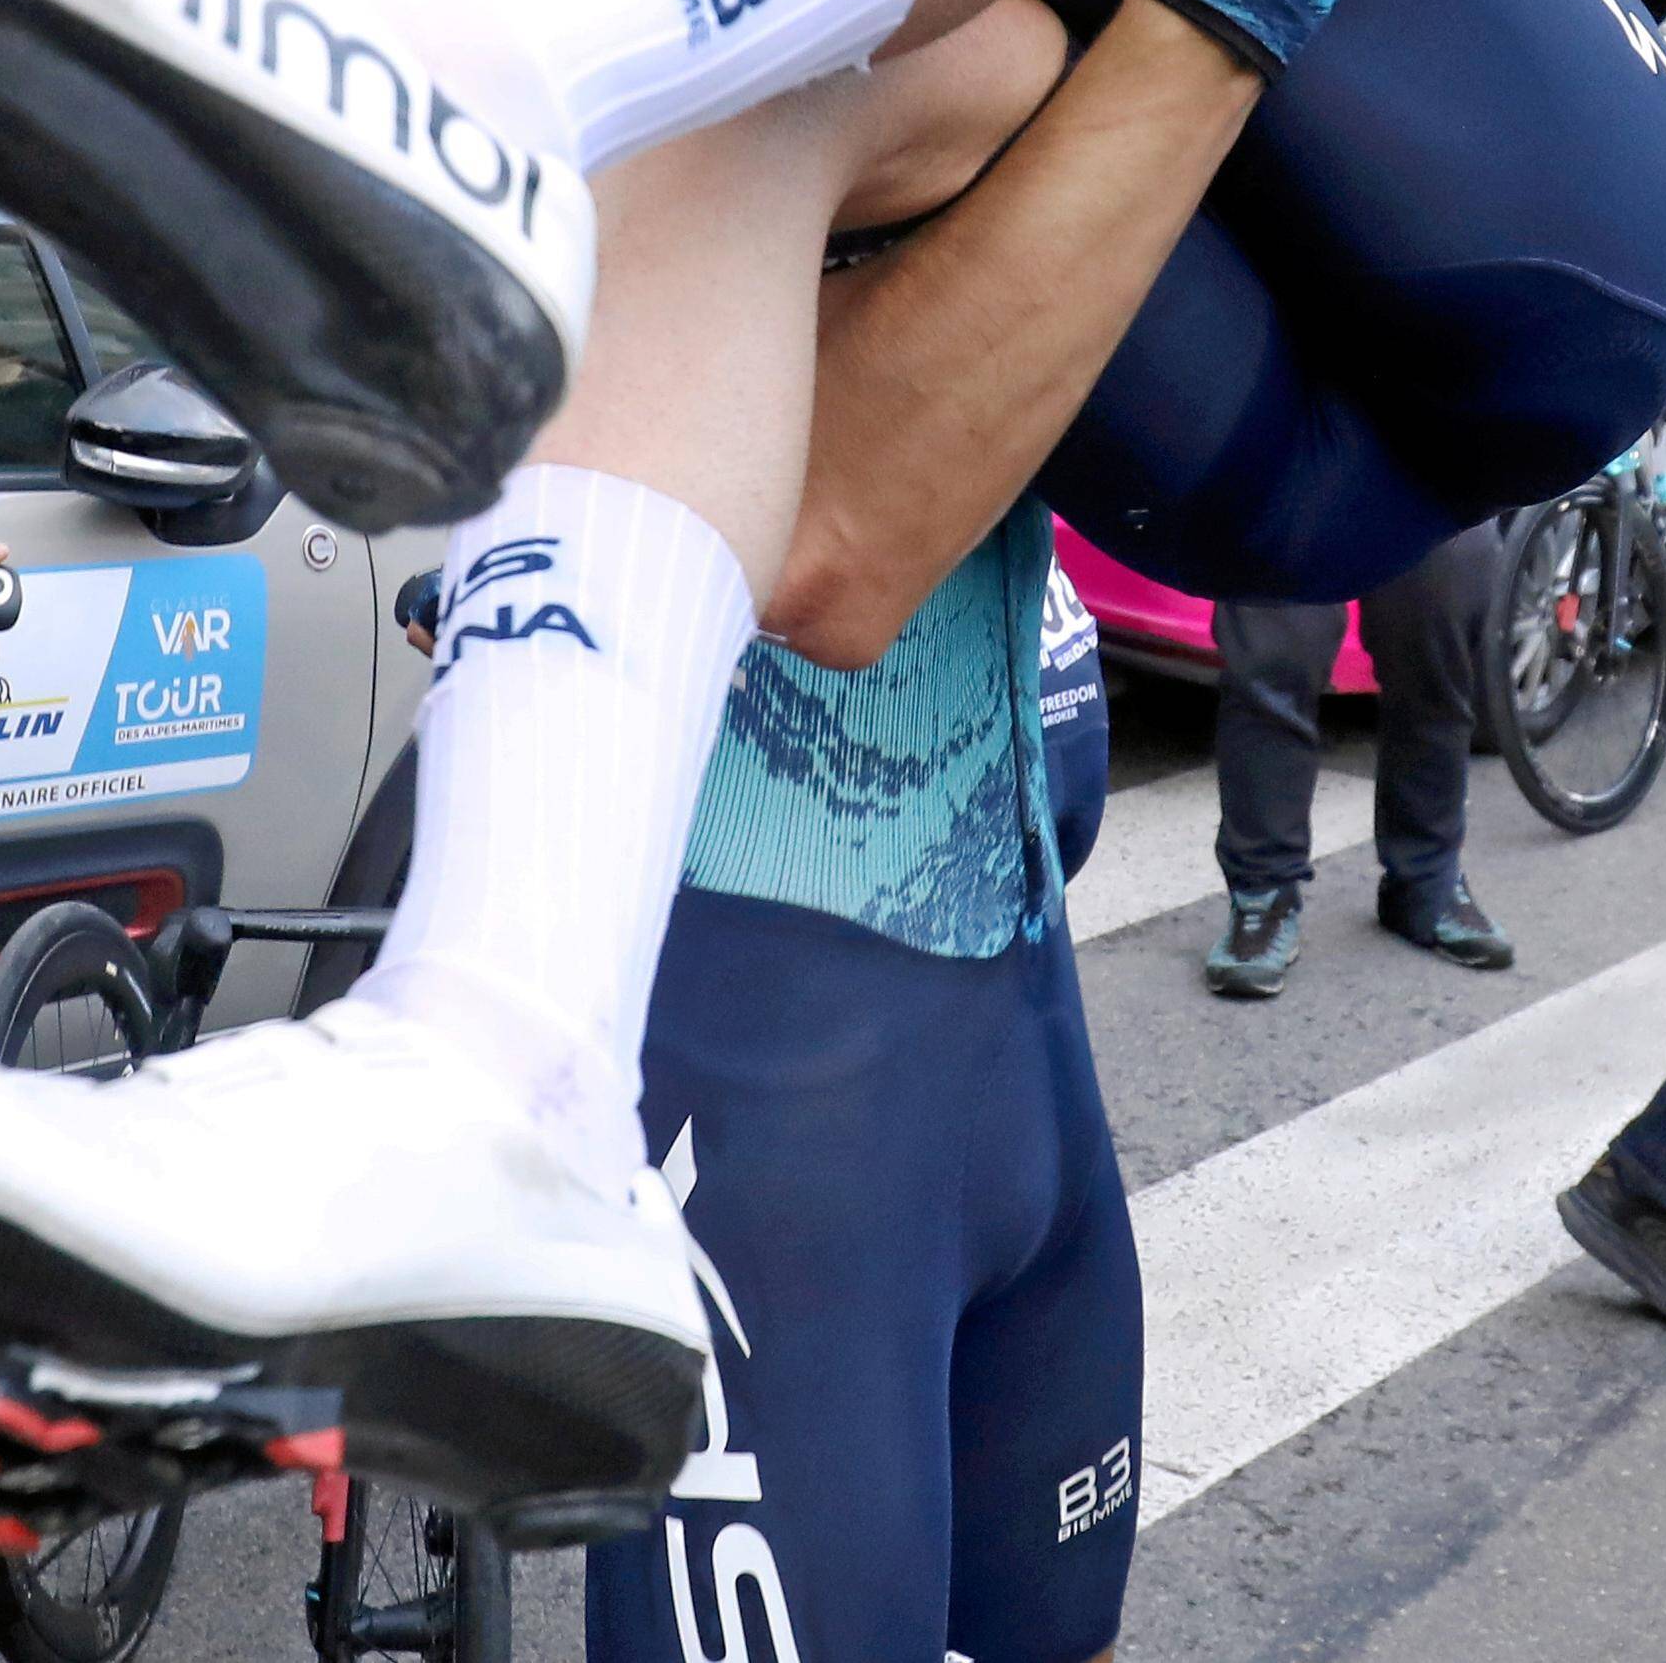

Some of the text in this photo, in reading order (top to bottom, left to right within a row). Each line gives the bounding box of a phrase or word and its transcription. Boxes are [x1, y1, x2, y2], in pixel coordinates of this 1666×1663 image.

[150, 595, 231, 614] CLASSIC
[151, 608, 232, 656] VAR
[114, 673, 223, 724] TOUR
[1039, 682, 1099, 716] FREEDOM
[117, 716, 241, 742] DES ALPES-MARITIMES
[1041, 705, 1080, 729] BROKER
[65, 773, 147, 801] OFFICIEL
[1058, 1435, 1131, 1527] B3
[1057, 1478, 1133, 1544] BIEMME
